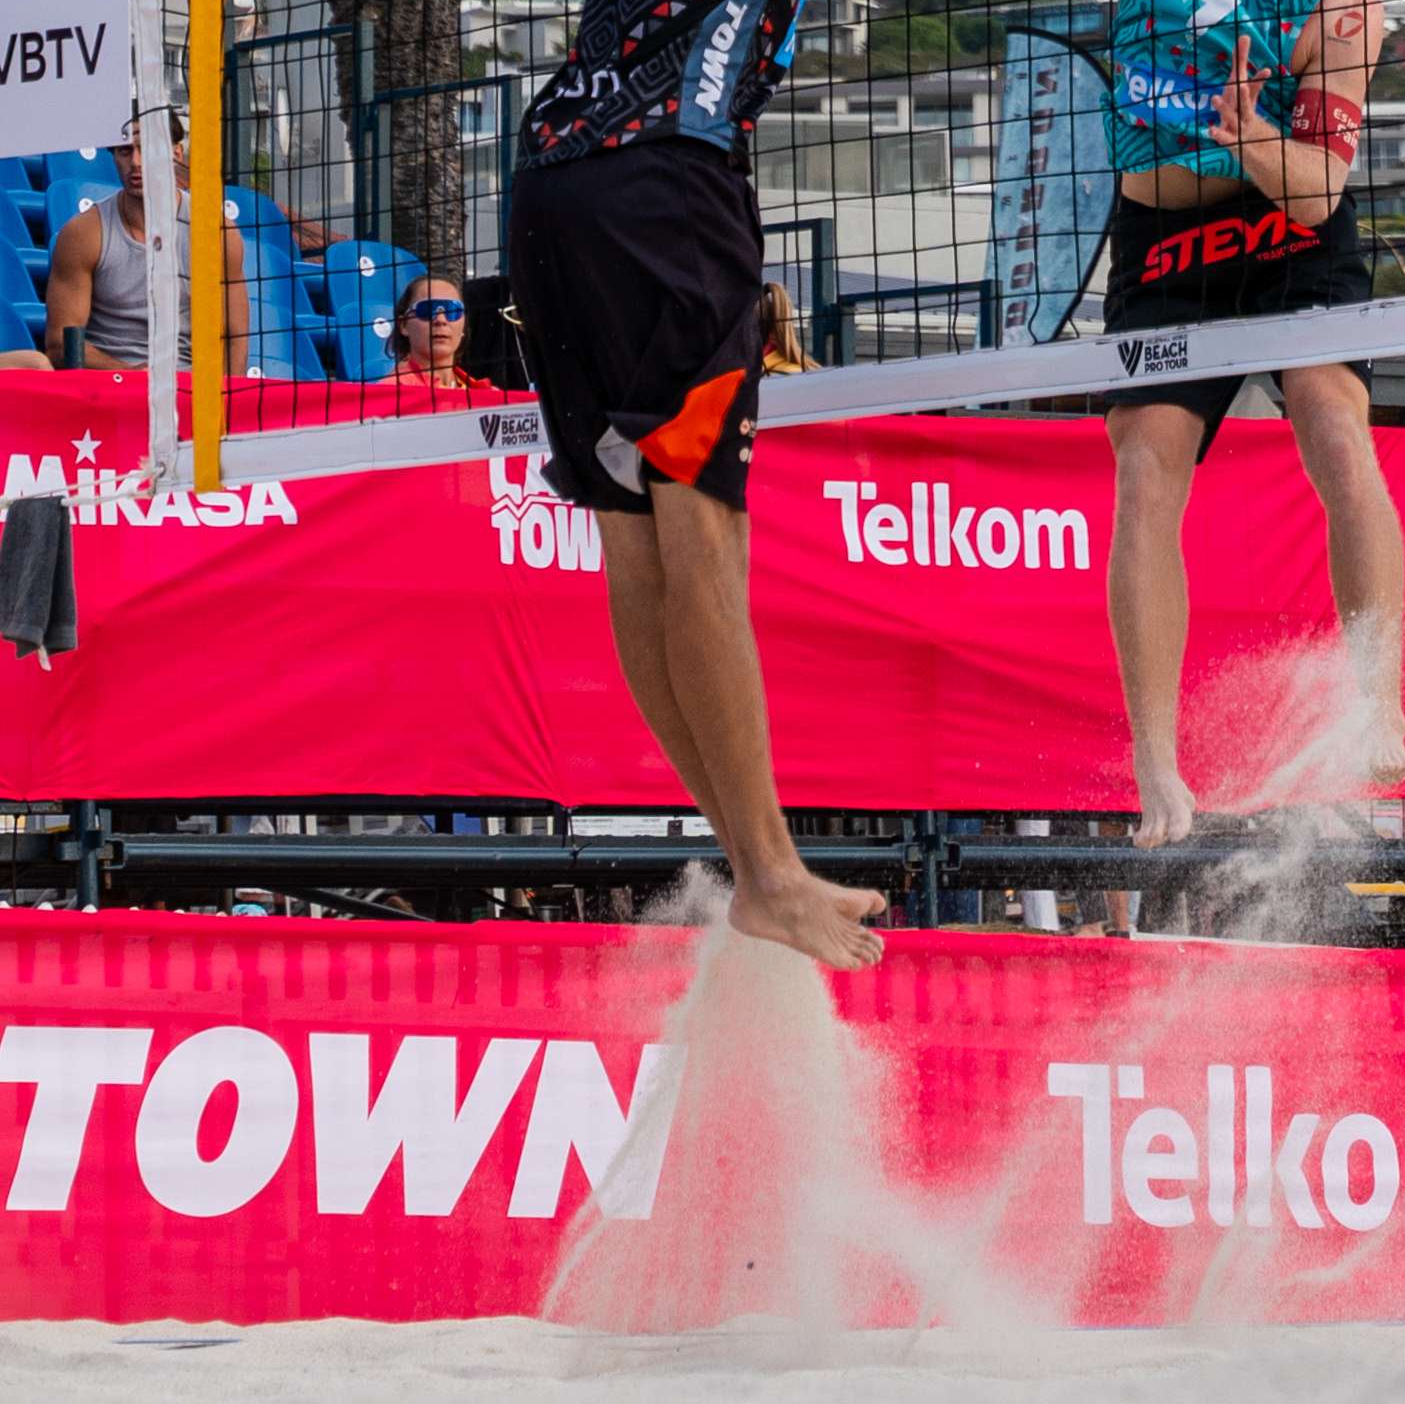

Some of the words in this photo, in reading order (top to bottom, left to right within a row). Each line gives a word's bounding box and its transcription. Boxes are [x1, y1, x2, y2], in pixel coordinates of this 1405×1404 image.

[694, 1, 748, 117] TOWN
[1144, 340, 1188, 362] BEACH
[1144, 361, 1164, 373] PRO
[1164, 357, 1188, 370] TOUR
[501, 418, 539, 435] BEACH
[501, 435, 518, 446] PRO
[823, 480, 1090, 570] Telkom
[0, 1025, 688, 1220] TOWN
